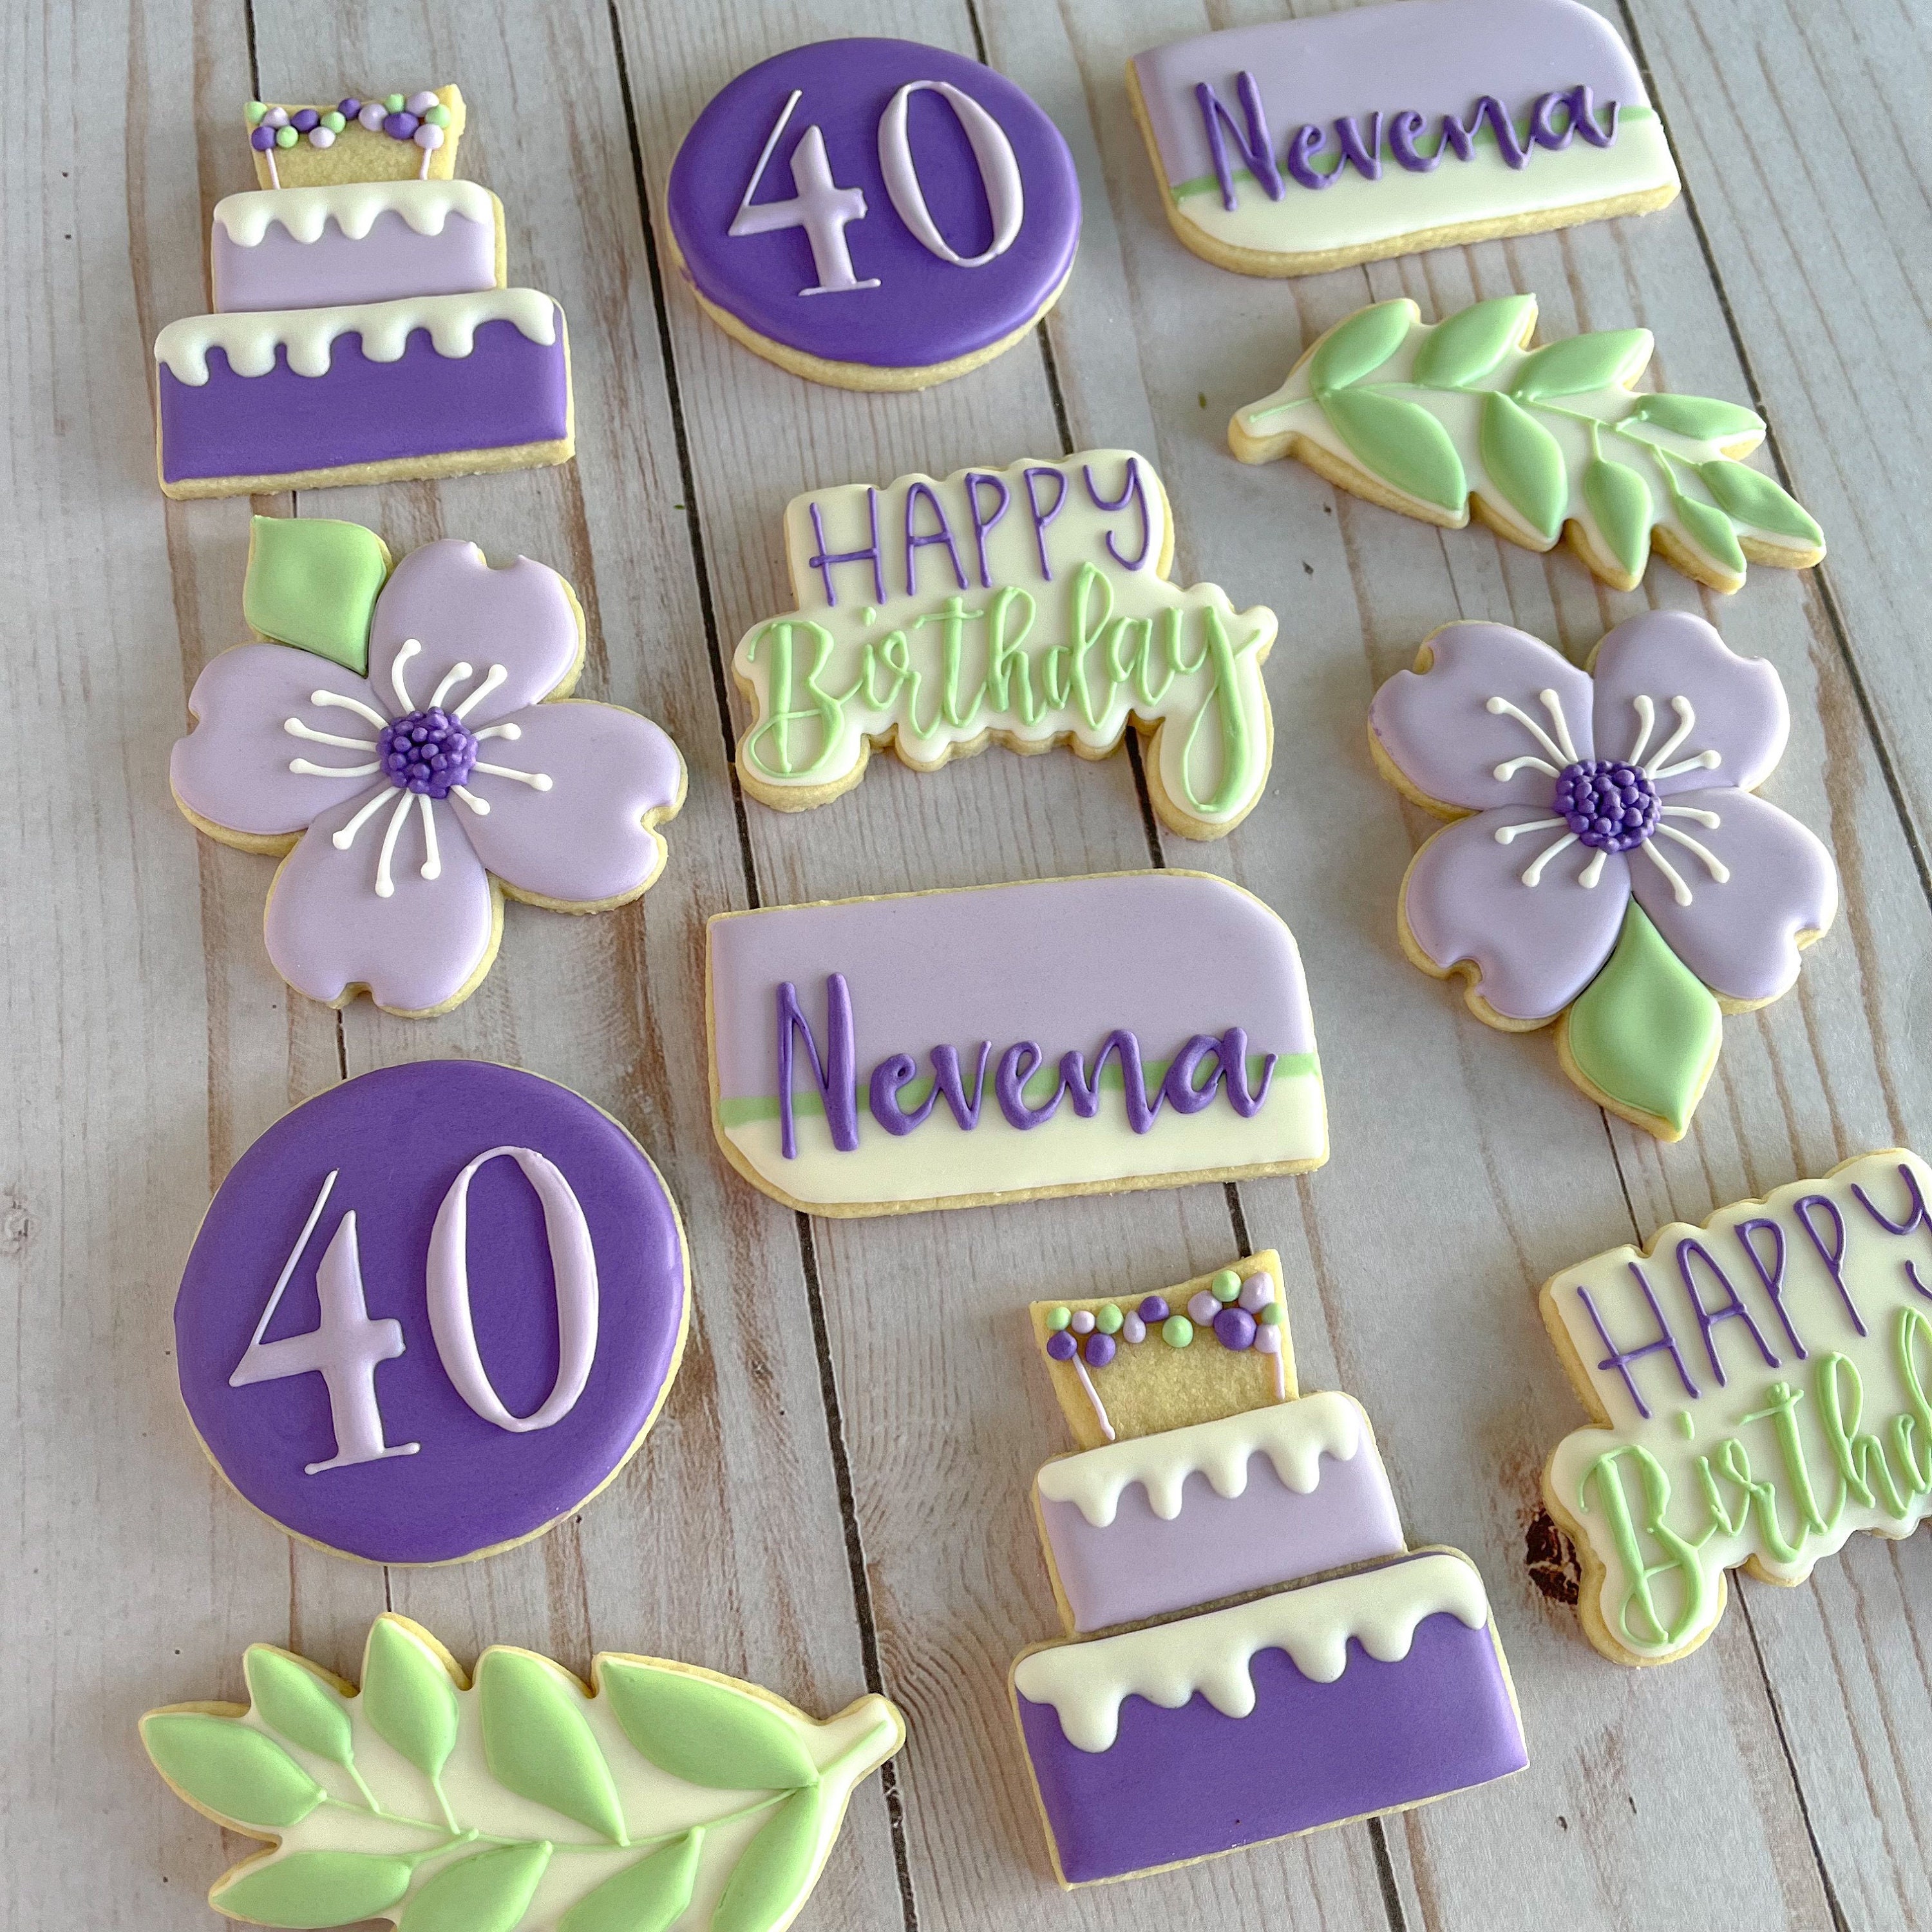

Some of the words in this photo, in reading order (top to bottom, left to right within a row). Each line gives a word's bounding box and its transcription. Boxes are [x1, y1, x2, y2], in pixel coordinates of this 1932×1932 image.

[728, 80, 1024, 297] 40
[1195, 70, 1622, 211] Nevena
[808, 457, 1150, 606] HAPPY
[746, 561, 1262, 813] Birthday
[777, 972, 1278, 1159] Nevena
[229, 1145, 600, 1475] 40
